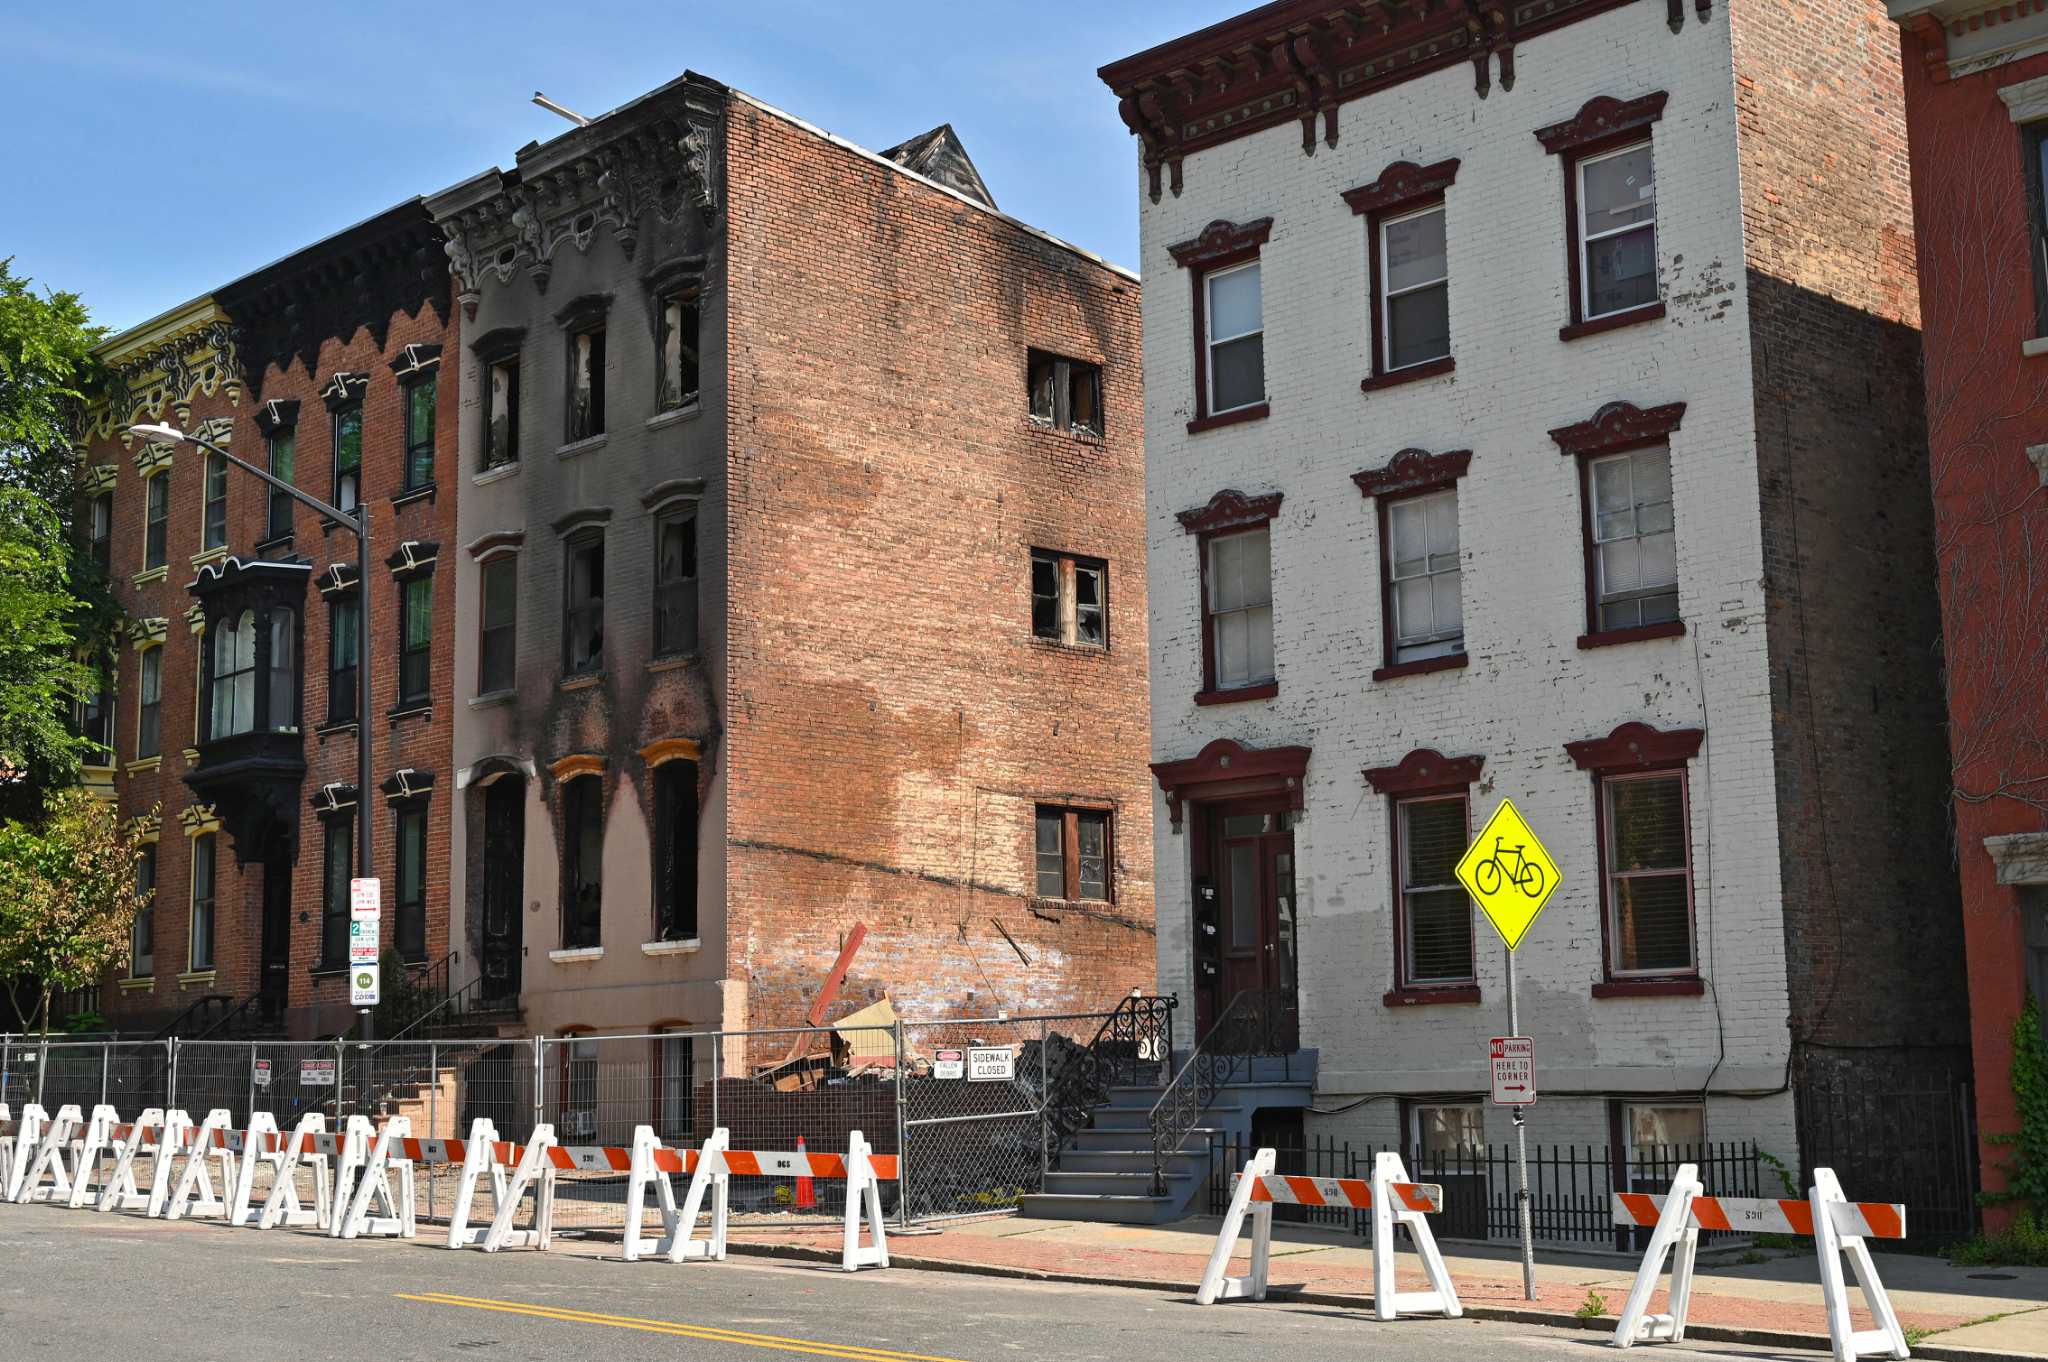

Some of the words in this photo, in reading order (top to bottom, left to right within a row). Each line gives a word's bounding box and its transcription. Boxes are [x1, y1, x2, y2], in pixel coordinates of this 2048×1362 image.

[352, 923, 359, 934] 2
[1491, 1042, 1503, 1054] NO
[1505, 1044, 1530, 1053] PARKING
[973, 1053, 1009, 1063] SIDEWALK
[978, 1065, 1006, 1075] CLOSED
[1496, 1061, 1516, 1070] HERE
[1519, 1061, 1528, 1070] TO
[1497, 1072, 1528, 1081] CORNER
